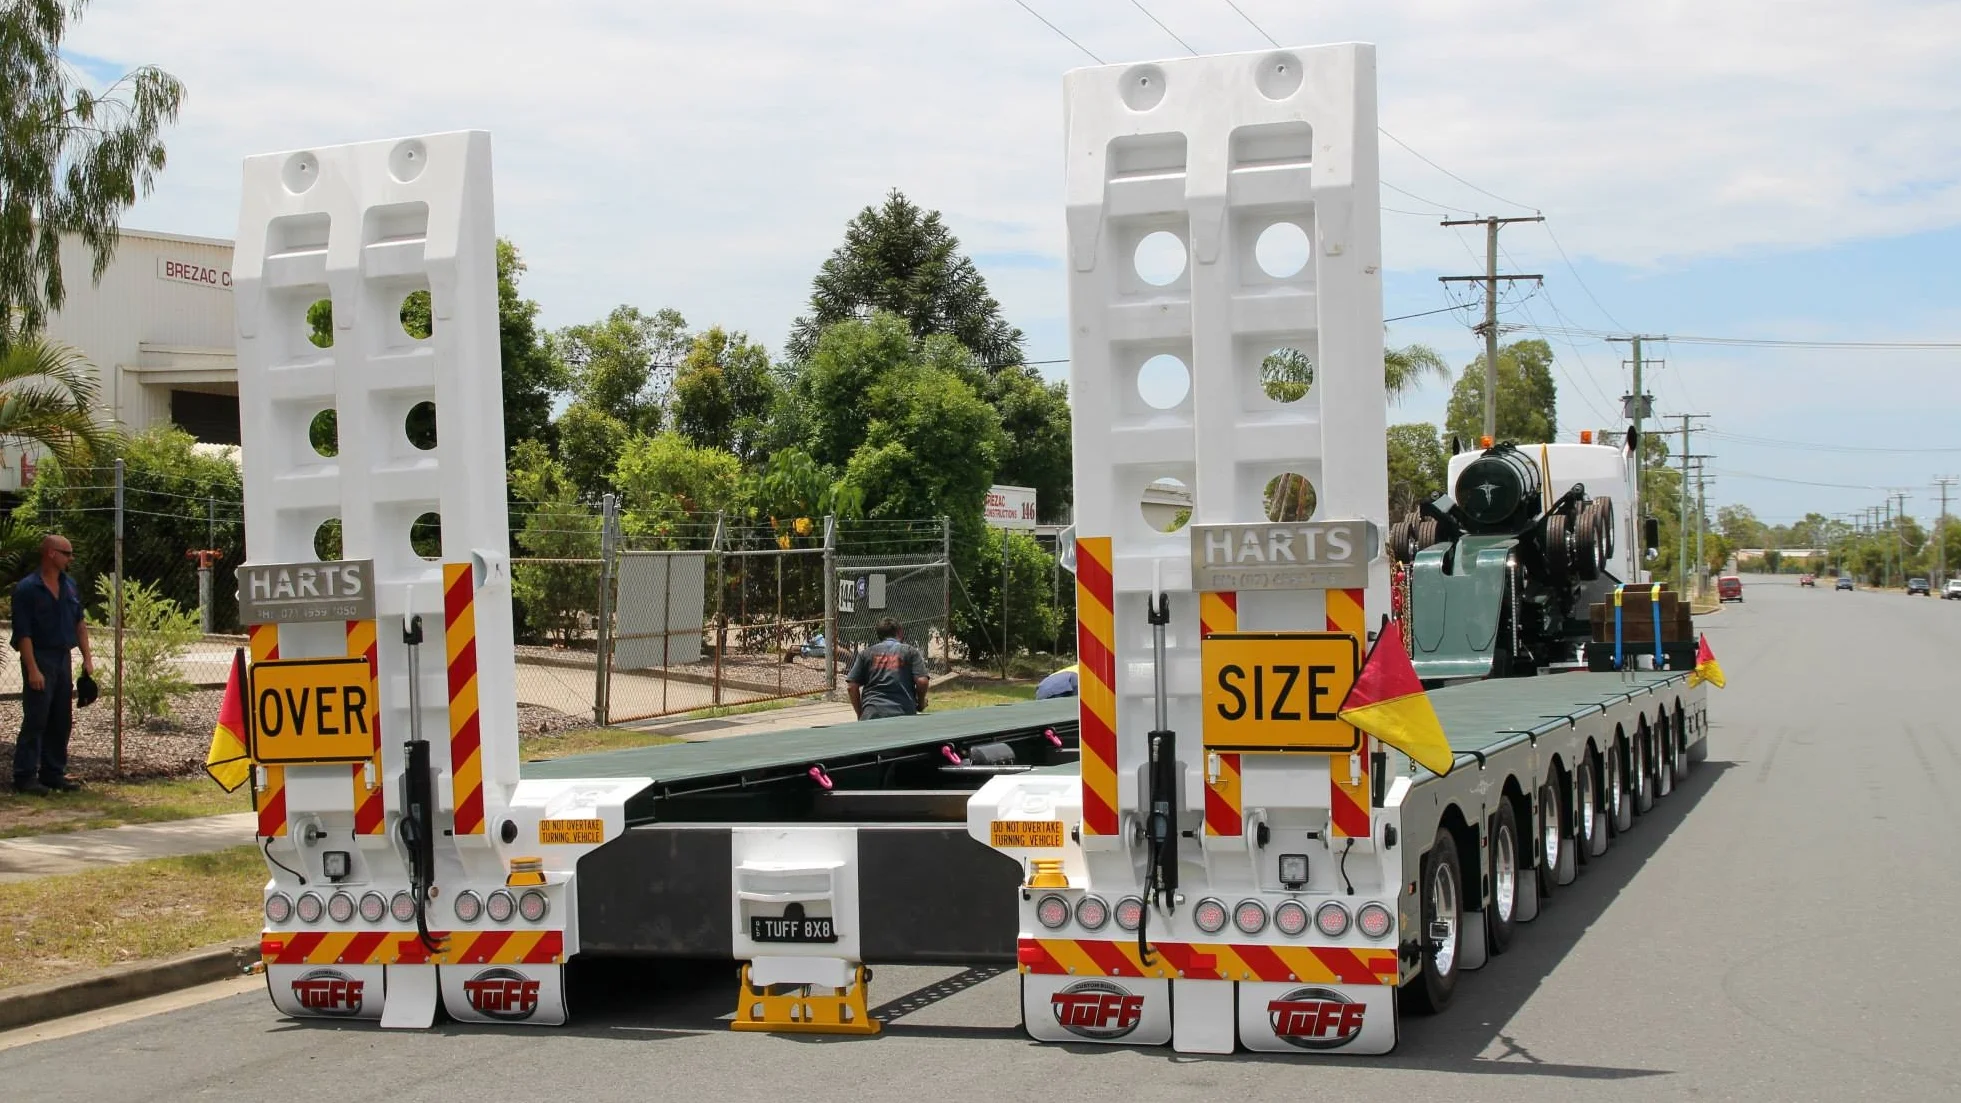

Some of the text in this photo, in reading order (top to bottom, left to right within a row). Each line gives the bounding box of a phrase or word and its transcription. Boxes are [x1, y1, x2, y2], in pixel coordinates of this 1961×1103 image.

[166, 261, 233, 287] BREZAC C
[1021, 502, 1035, 520] 146
[1203, 526, 1353, 563] HARTS
[250, 564, 362, 600] HARTS
[1217, 664, 1337, 721] SIZE
[259, 685, 368, 737] OVER
[541, 819, 600, 831] DO NOT OVERTAKE
[993, 821, 1060, 833] DO NOT OVERTAKE
[542, 832, 600, 843] TURNING VEHICLE
[995, 834, 1060, 846] TURNING VEHICLE
[765, 921, 830, 938] TUFF 8X8
